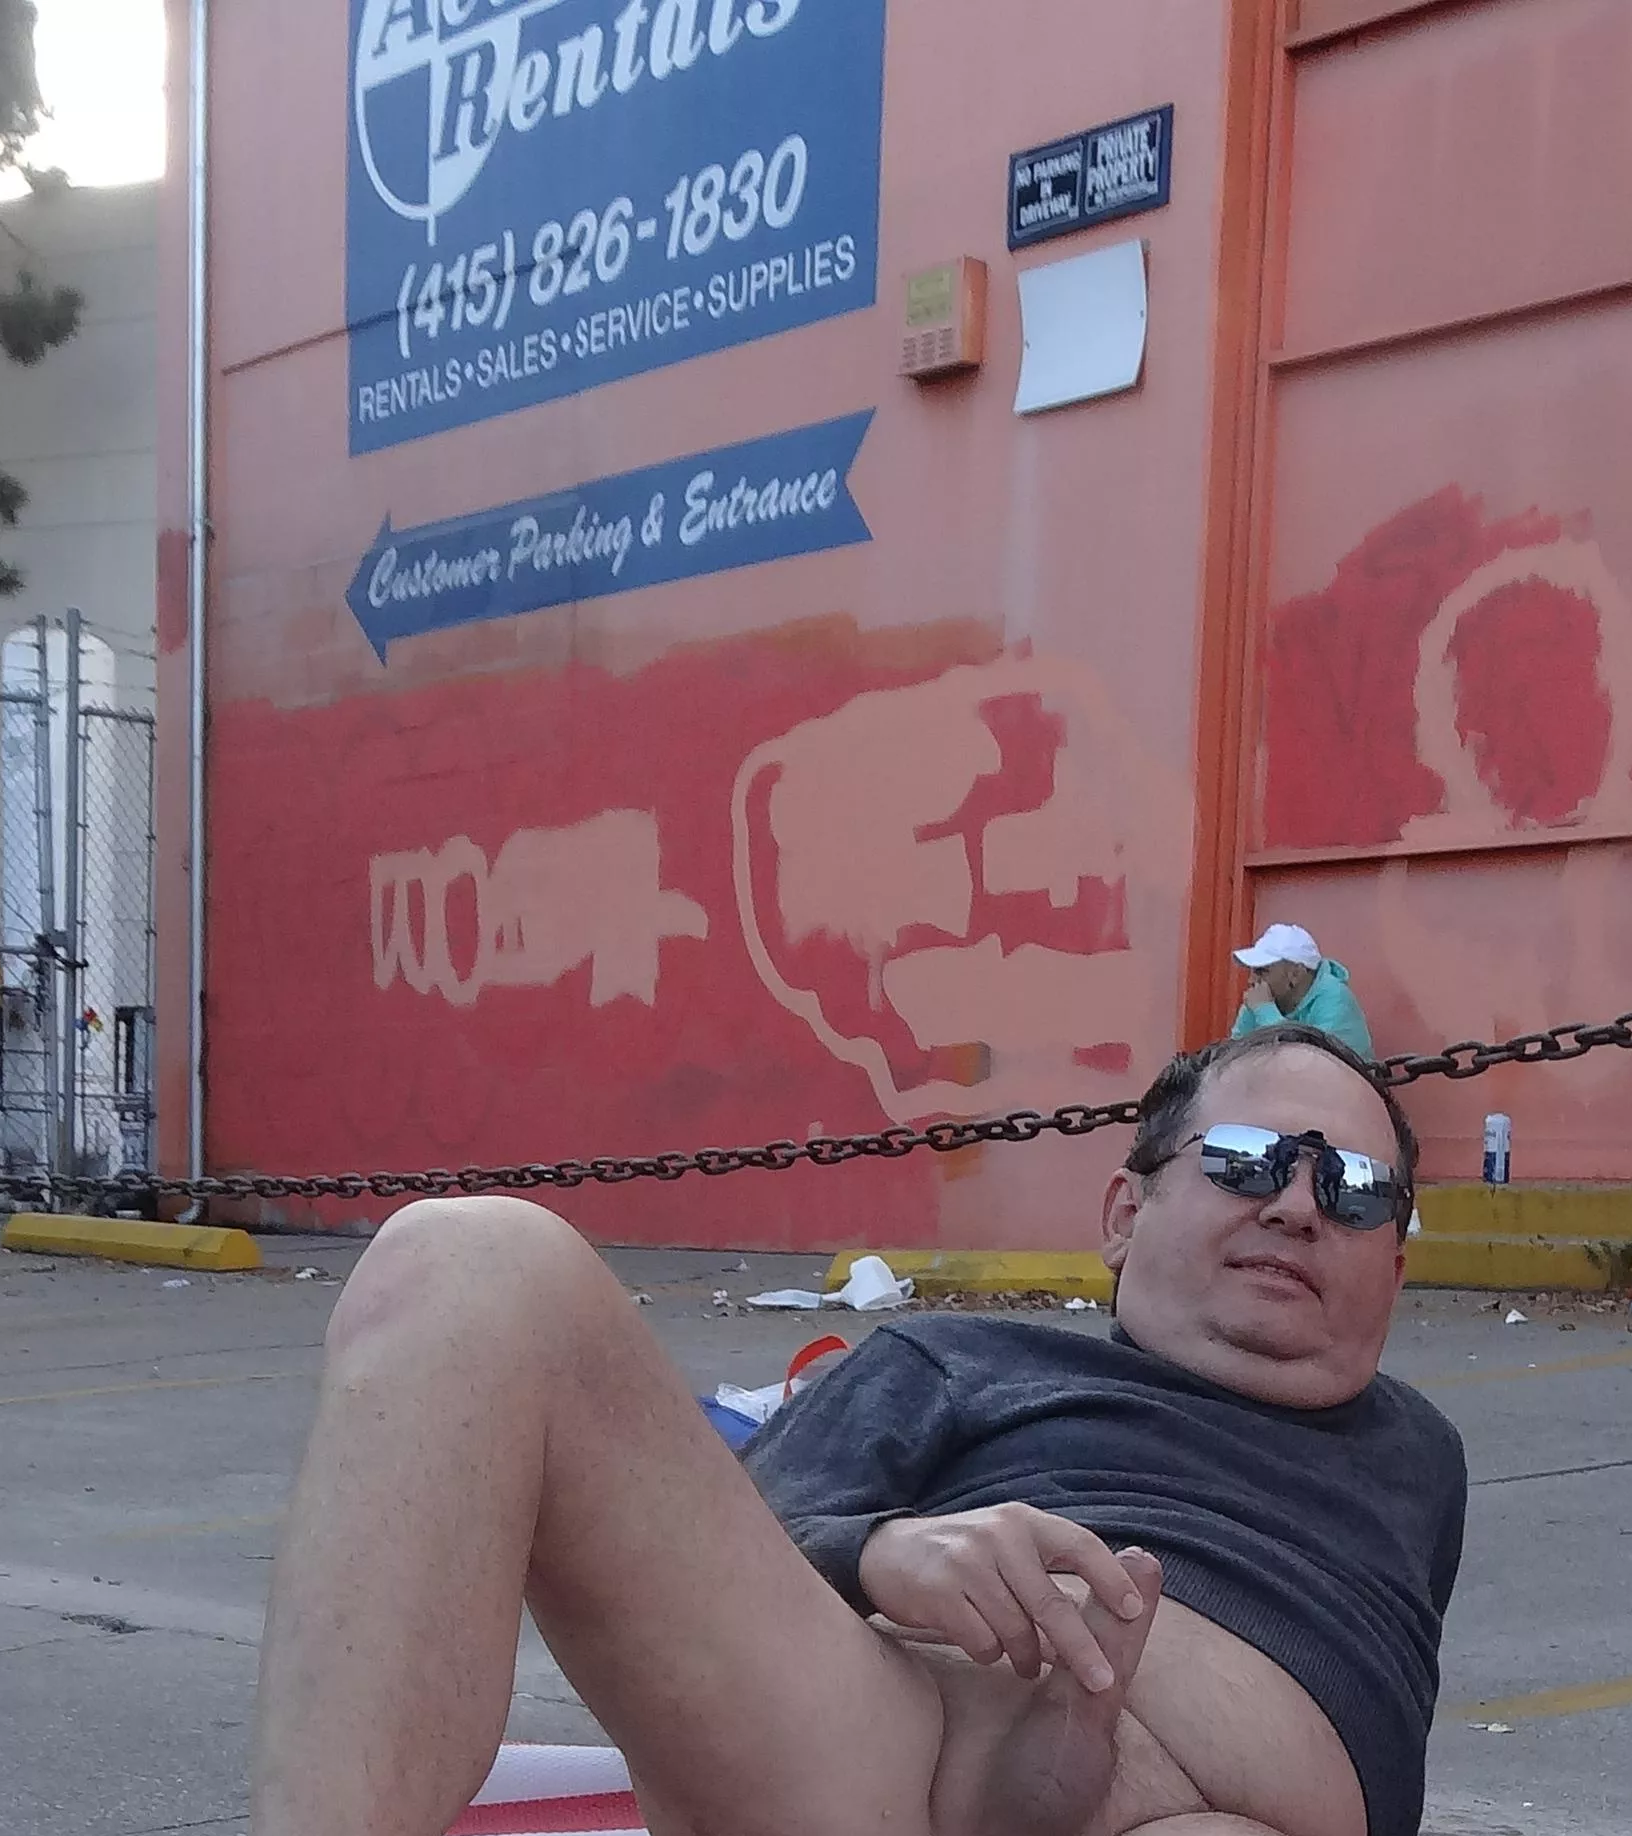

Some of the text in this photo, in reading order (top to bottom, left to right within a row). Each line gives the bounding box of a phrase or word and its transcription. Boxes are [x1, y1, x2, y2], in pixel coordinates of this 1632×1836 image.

[1033, 151, 1081, 185] PARKING
[1087, 147, 1155, 195] PROPERTY
[1097, 120, 1151, 167] PRIVATE
[397, 133, 808, 359] (415) 826-1830
[357, 360, 462, 424] RENTALS
[474, 328, 558, 390] SALES
[574, 287, 691, 359] SERVICE
[707, 234, 856, 320] SUPPLIES
[367, 466, 838, 608] Customer Parking & Entrance
